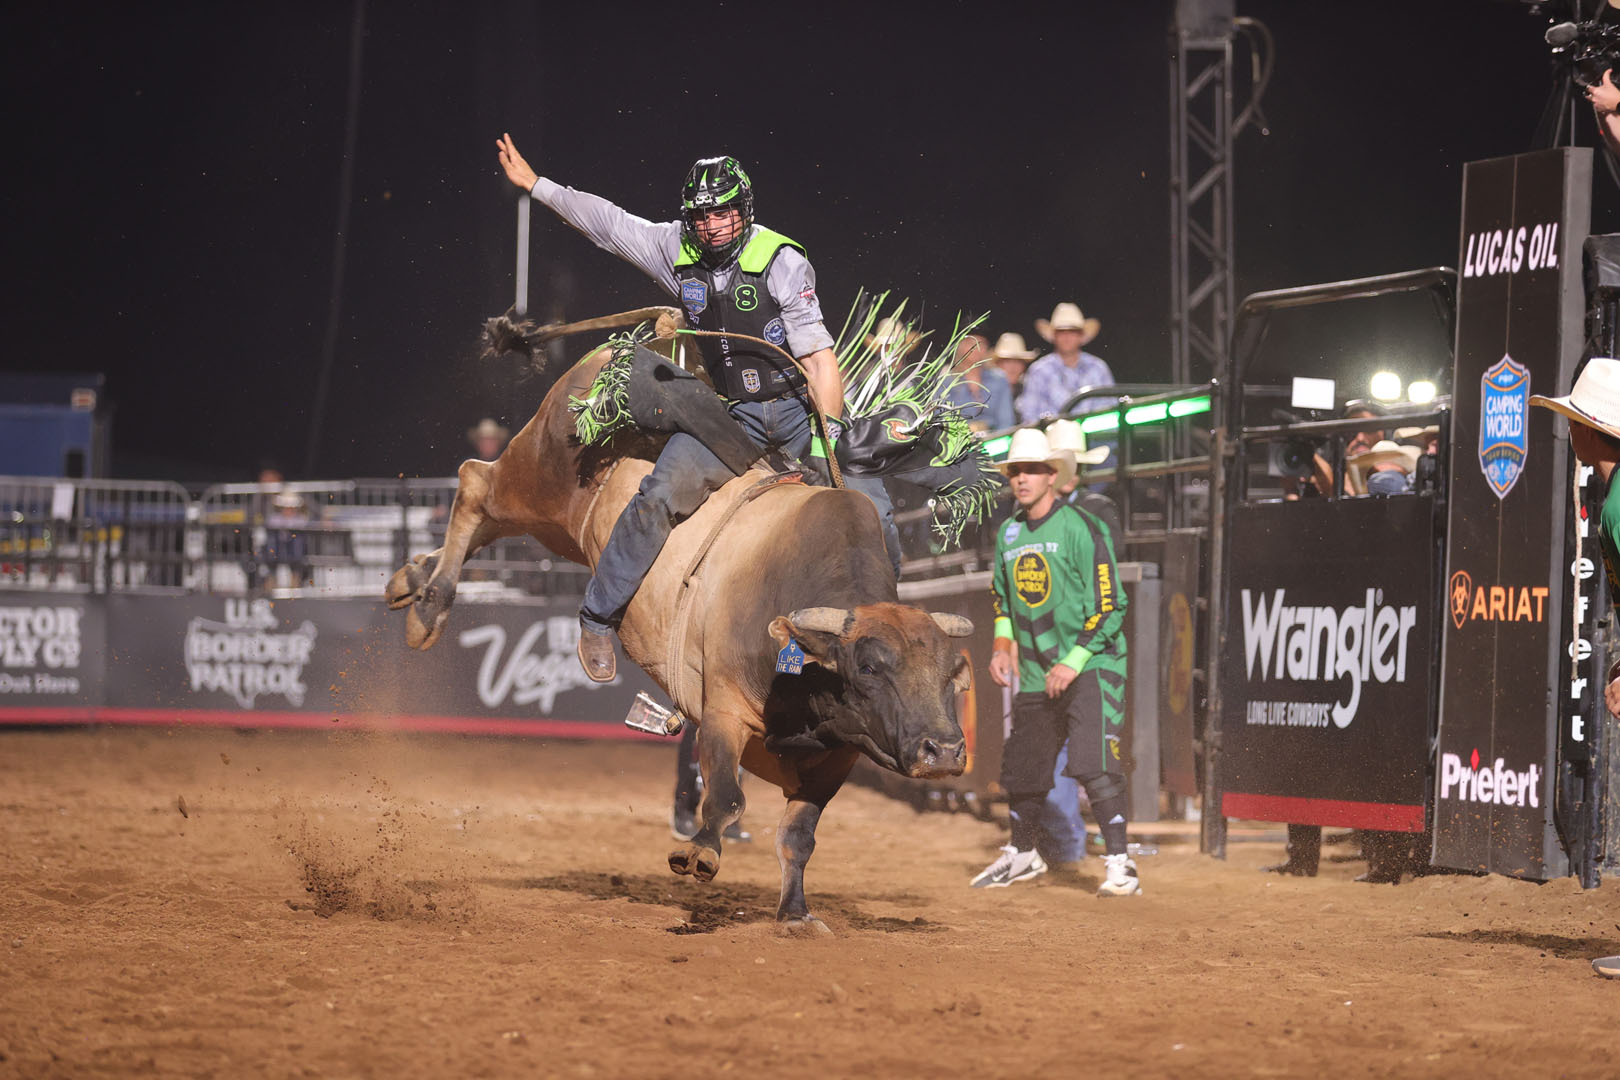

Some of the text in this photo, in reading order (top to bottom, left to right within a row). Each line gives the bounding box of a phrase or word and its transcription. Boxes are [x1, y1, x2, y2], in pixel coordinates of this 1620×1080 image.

[1463, 222, 1558, 278] LUCAS OIL
[735, 284, 758, 311] 8
[1486, 394, 1522, 415] CAMPING
[1486, 414, 1522, 438] WORLD
[1471, 586, 1548, 622] ARIAT
[0, 638, 37, 668] LY
[458, 621, 623, 715] Vega
[780, 654, 801, 664] LIKE
[1241, 587, 1416, 729] Wrangler
[1246, 700, 1268, 725] LONG
[1268, 701, 1287, 726] LIVE
[1441, 750, 1539, 808] Priefert
